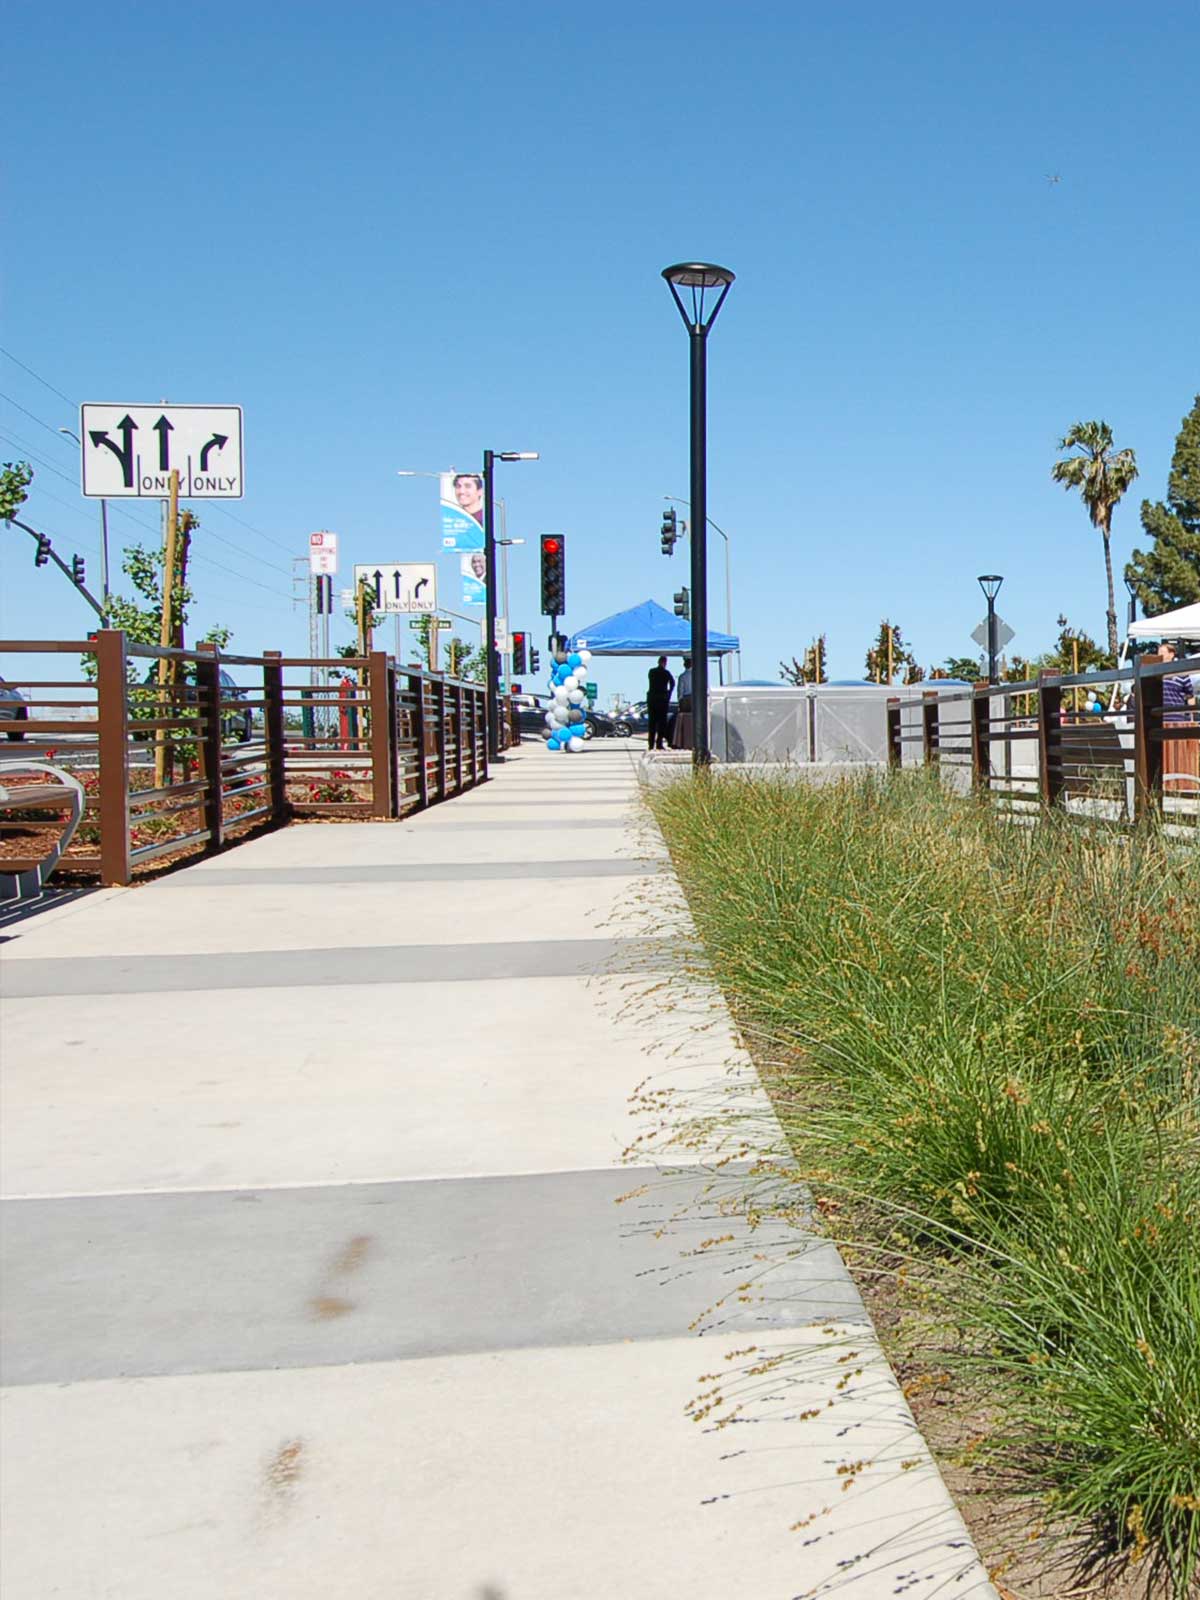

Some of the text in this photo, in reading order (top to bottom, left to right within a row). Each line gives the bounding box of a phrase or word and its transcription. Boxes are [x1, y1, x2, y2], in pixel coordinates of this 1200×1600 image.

[193, 476, 237, 490] ONLY
[386, 601, 434, 609] ONLY ONLY
